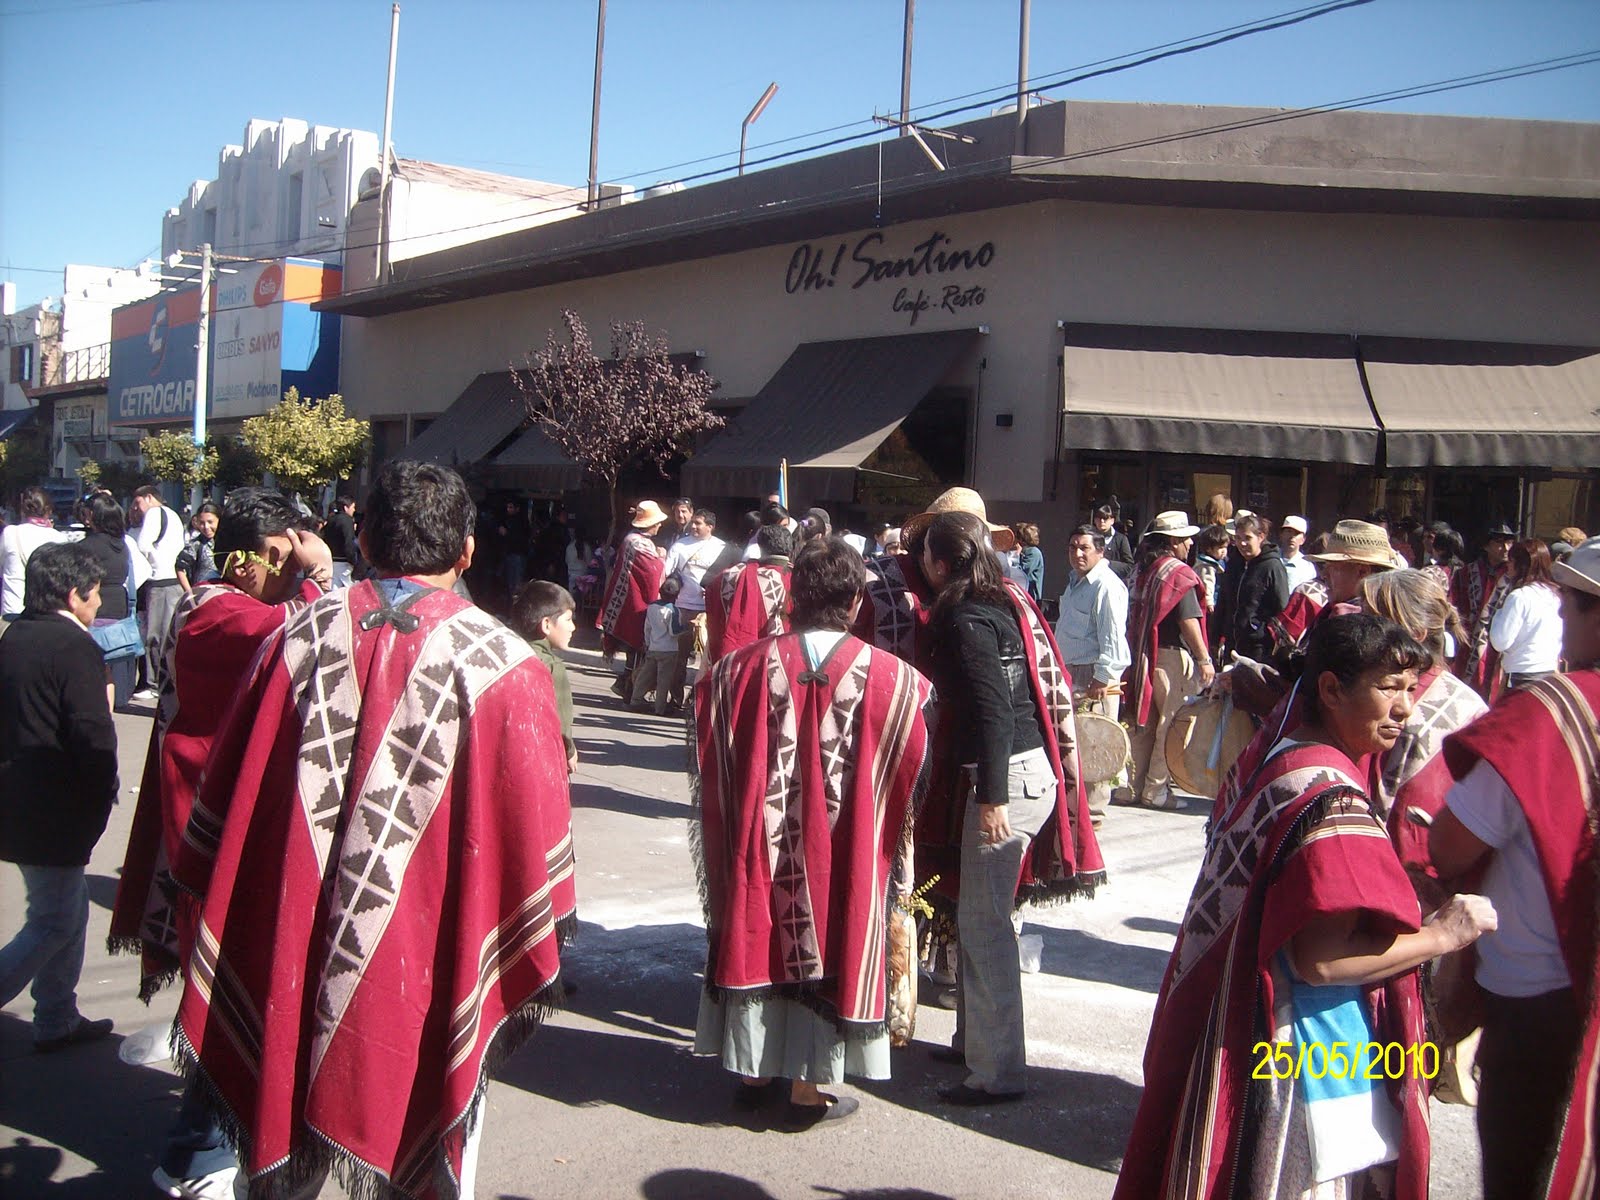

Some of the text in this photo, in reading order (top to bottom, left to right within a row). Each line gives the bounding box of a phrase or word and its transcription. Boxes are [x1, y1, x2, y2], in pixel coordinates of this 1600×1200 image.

[785, 232, 995, 293] Oh! Santino
[250, 332, 280, 355] SANYO
[121, 381, 195, 416] CETROGAR
